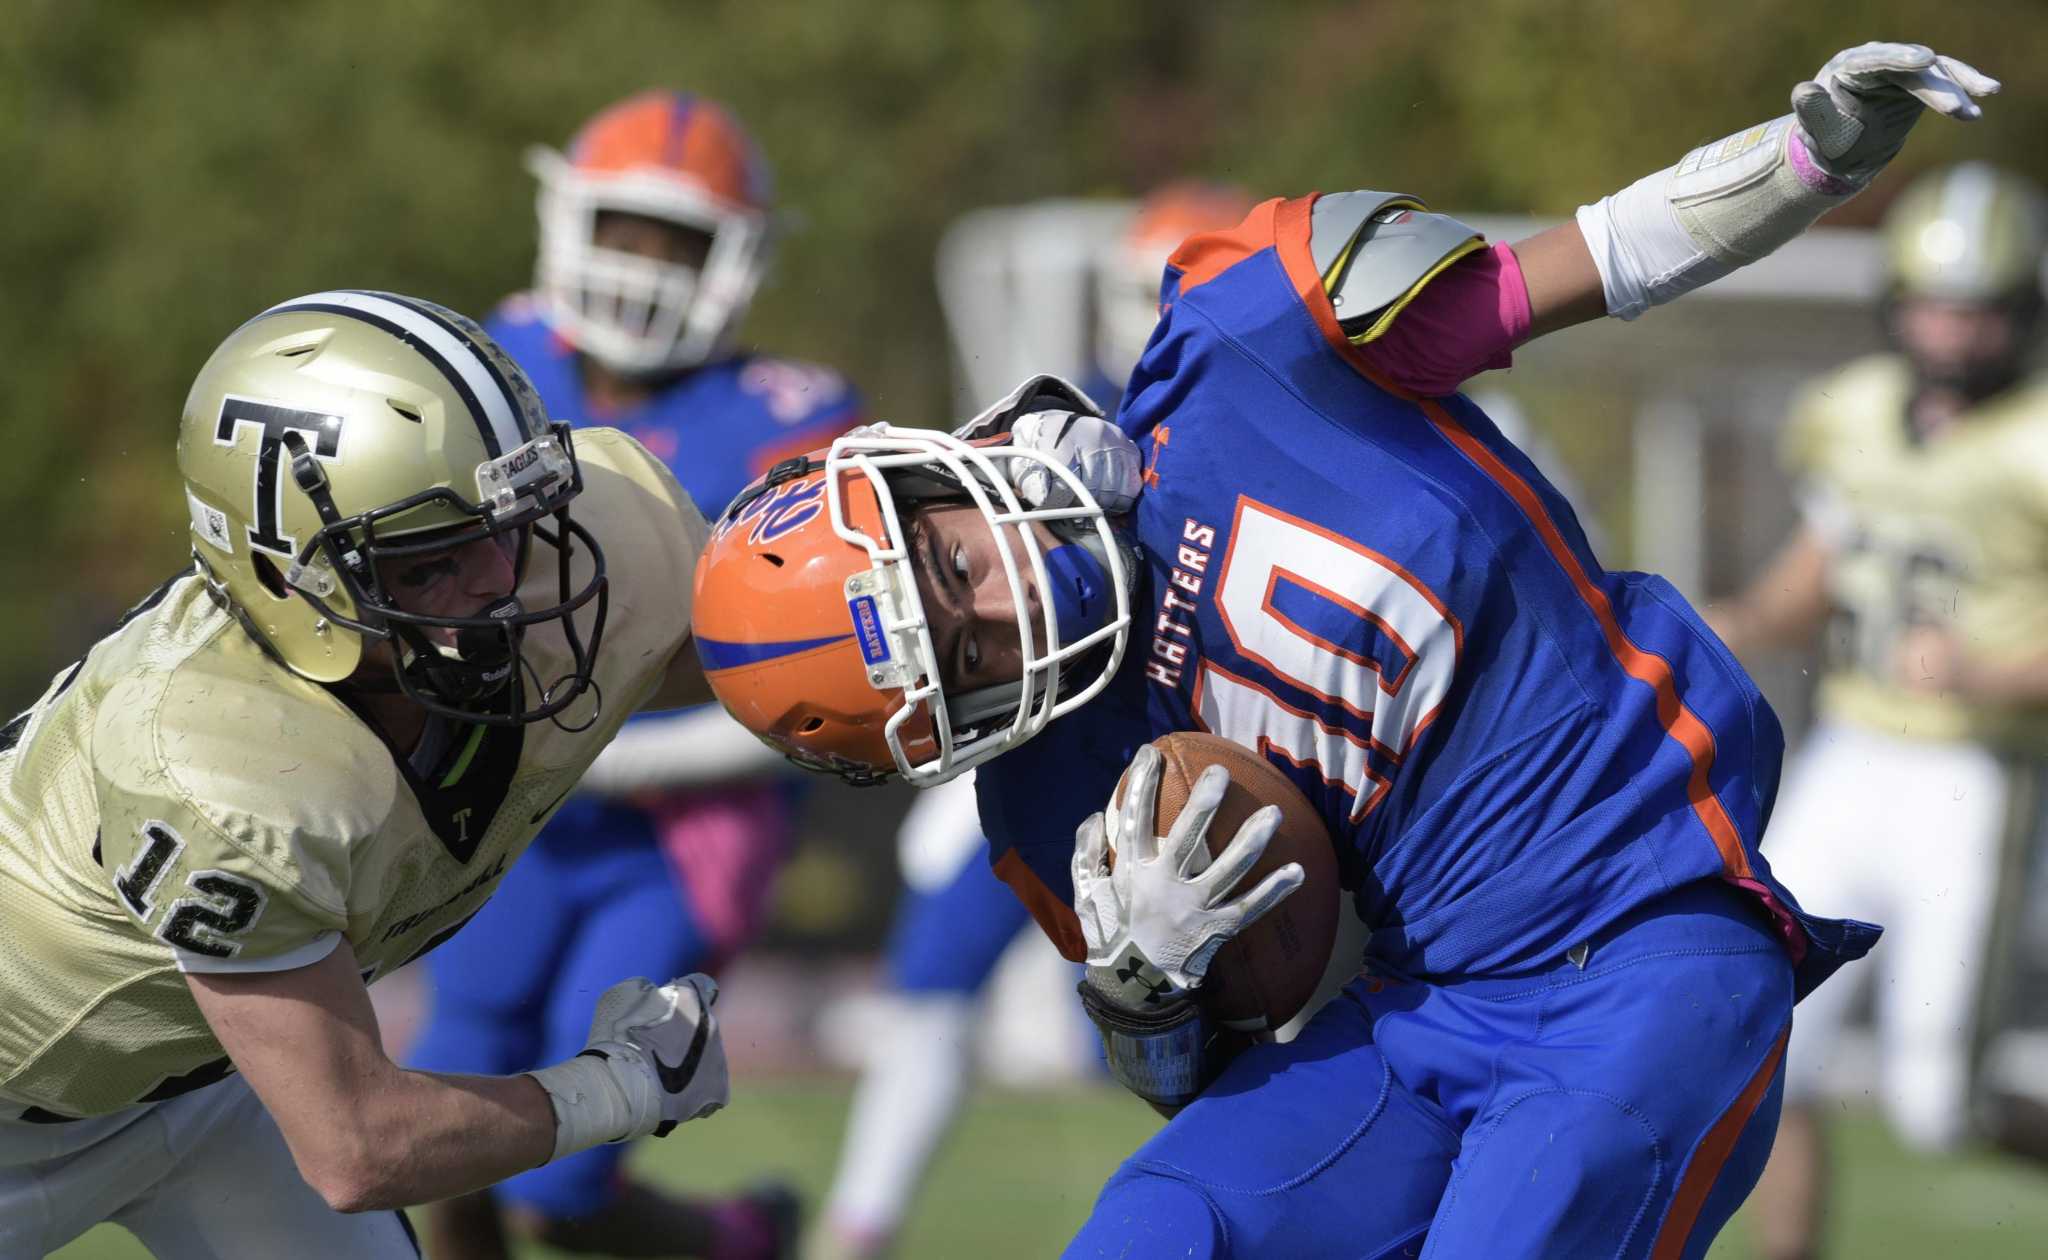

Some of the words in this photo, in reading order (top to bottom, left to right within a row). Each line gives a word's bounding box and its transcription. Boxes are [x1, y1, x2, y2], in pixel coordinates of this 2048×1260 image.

[213, 394, 347, 558] T
[501, 445, 539, 480] EAGLES
[1146, 518, 1216, 689] HATTERS
[1191, 493, 1465, 824] 10
[112, 818, 268, 959] 12
[452, 807, 472, 842] T
